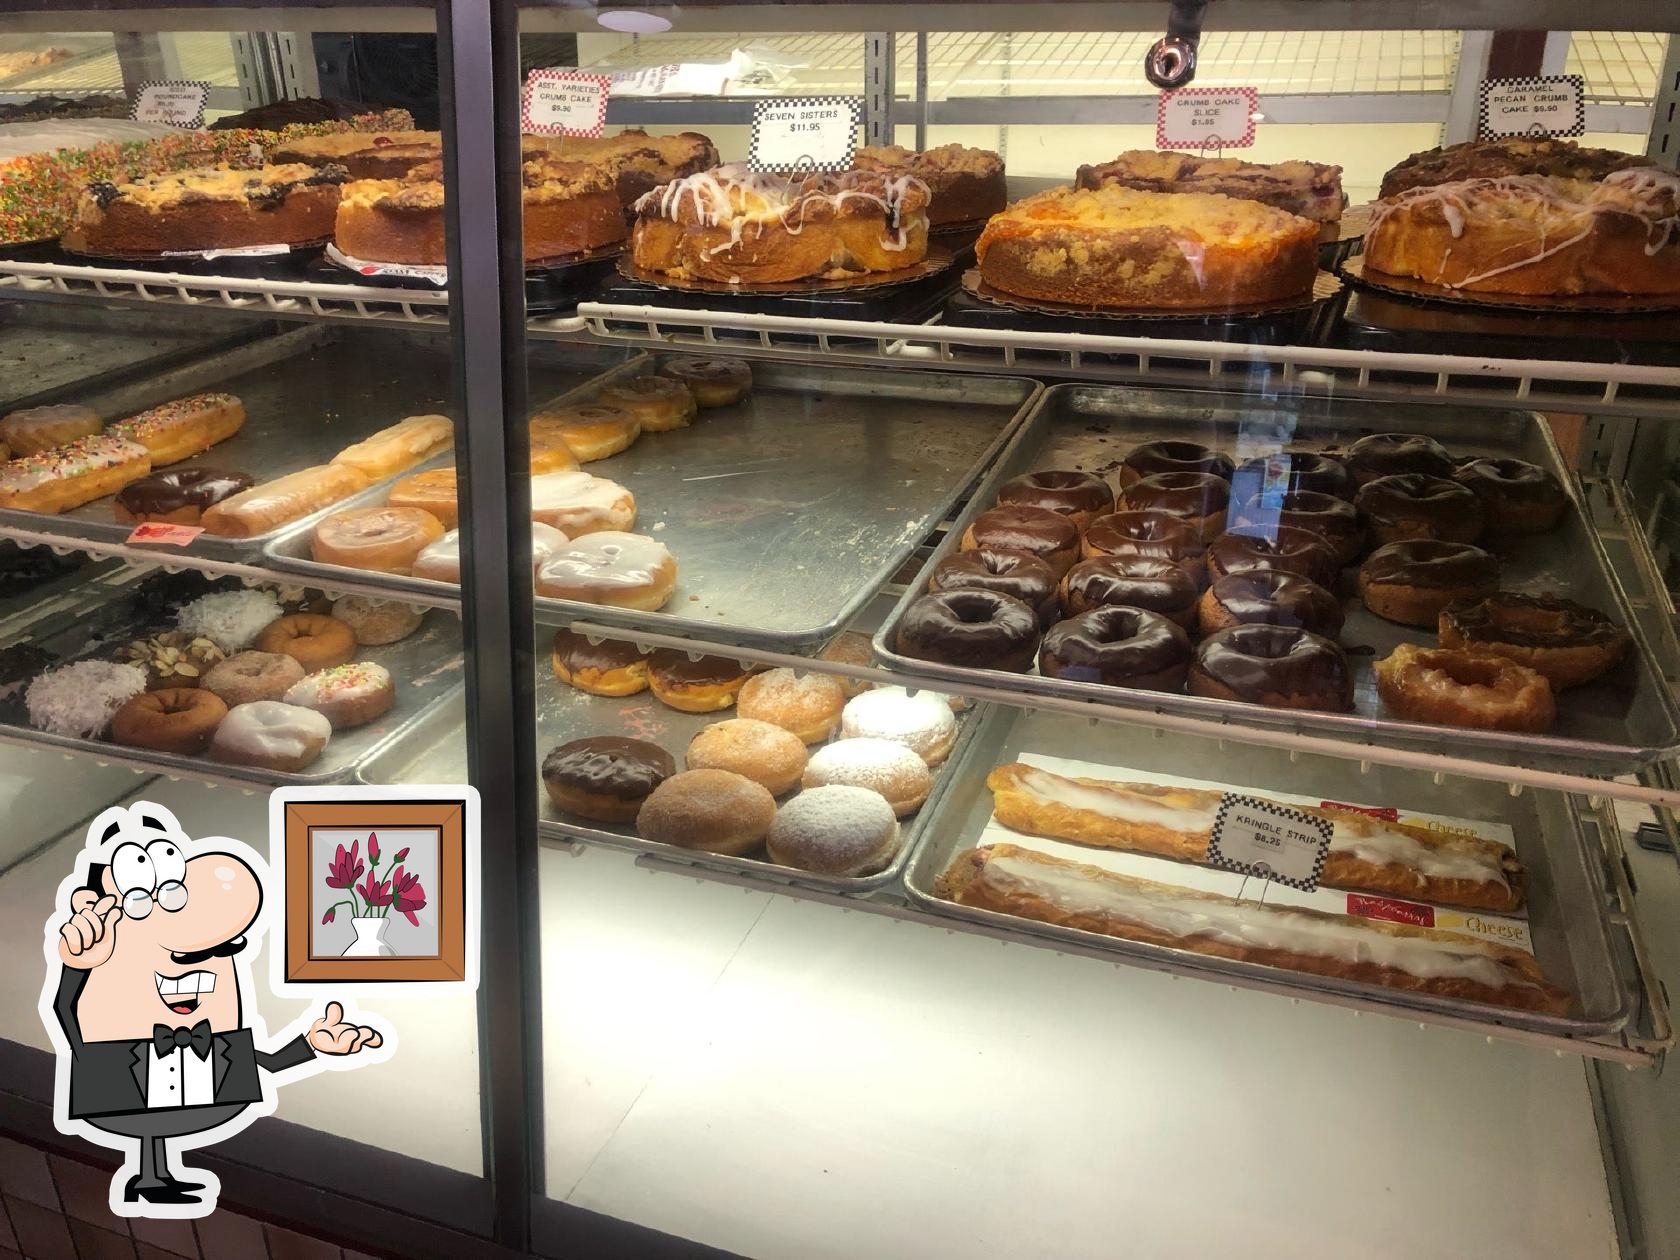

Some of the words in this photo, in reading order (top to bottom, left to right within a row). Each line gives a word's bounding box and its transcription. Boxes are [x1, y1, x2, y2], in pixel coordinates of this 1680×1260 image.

[538, 81, 557, 90] ASST.
[562, 84, 600, 94] VARIETIES
[1507, 85, 1553, 94] CARAMEL
[540, 93, 567, 102] CRUMB
[571, 95, 592, 103] CAKE
[1177, 99, 1210, 107] CRUMB
[1214, 98, 1241, 106] CAKE
[1494, 95, 1527, 103] PECAN
[1534, 94, 1568, 103] CRUMB
[1193, 108, 1221, 116] SLICE
[1502, 105, 1529, 114] CAKE
[764, 112, 796, 121] SEVEN
[800, 110, 839, 119] SISTERS
[789, 122, 821, 132] $11.95
[1236, 815, 1283, 835] KRINGLE
[1287, 829, 1318, 845] STRIP
[1466, 916, 1524, 940] Cheese
